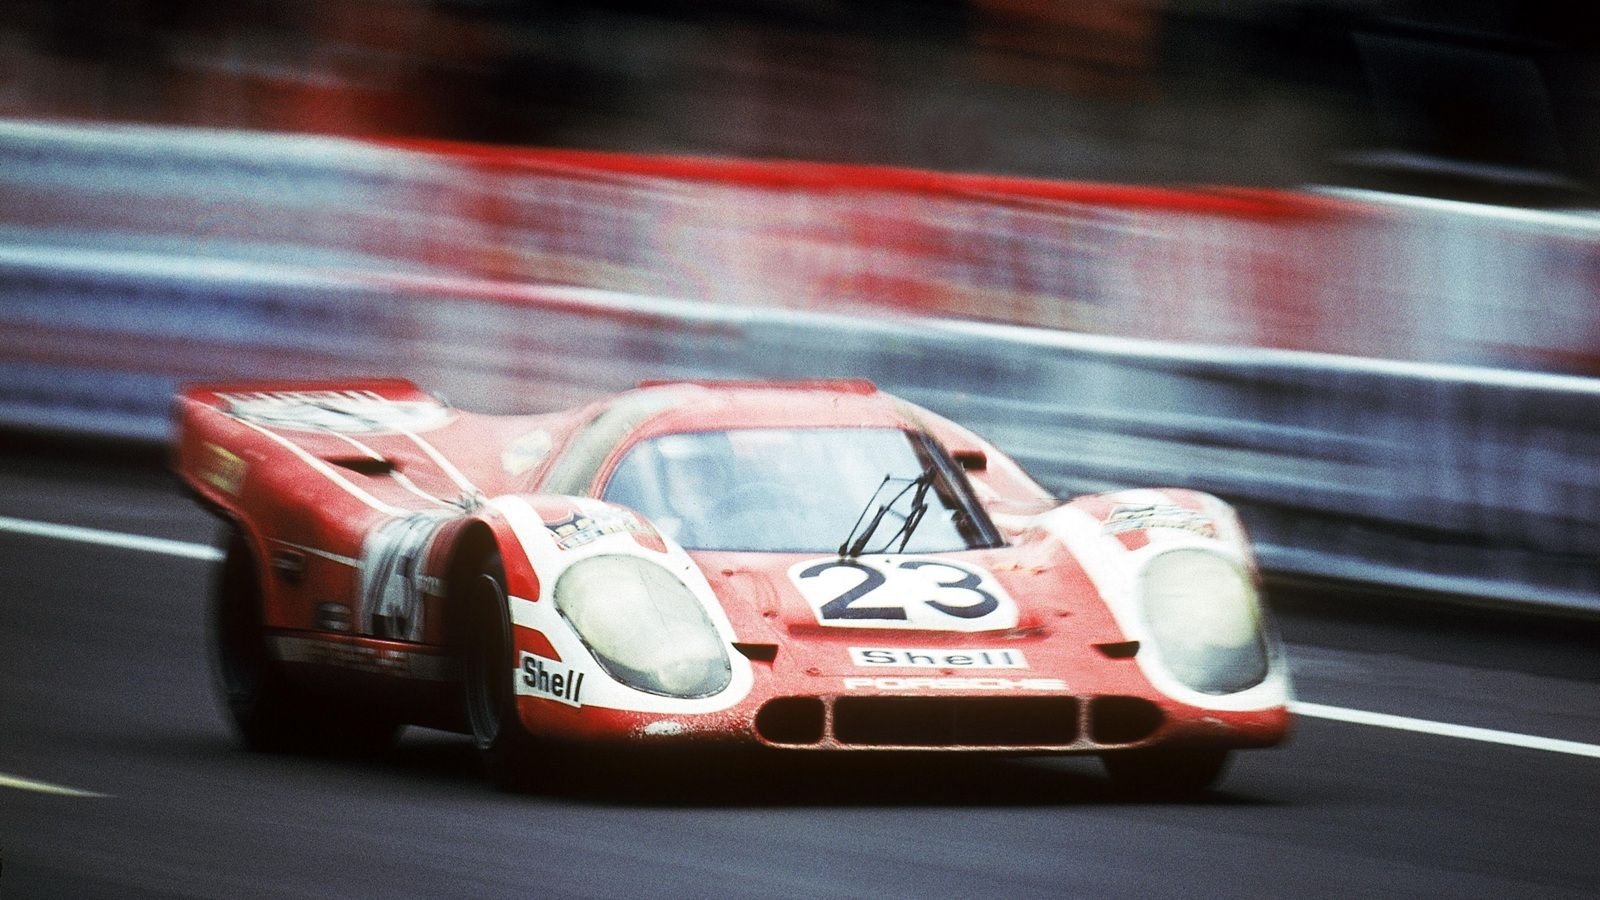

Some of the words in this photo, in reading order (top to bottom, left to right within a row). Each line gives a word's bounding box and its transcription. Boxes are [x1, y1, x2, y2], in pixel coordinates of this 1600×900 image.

[800, 560, 999, 620] 23
[522, 656, 584, 702] Shell
[861, 650, 1015, 666] Shell
